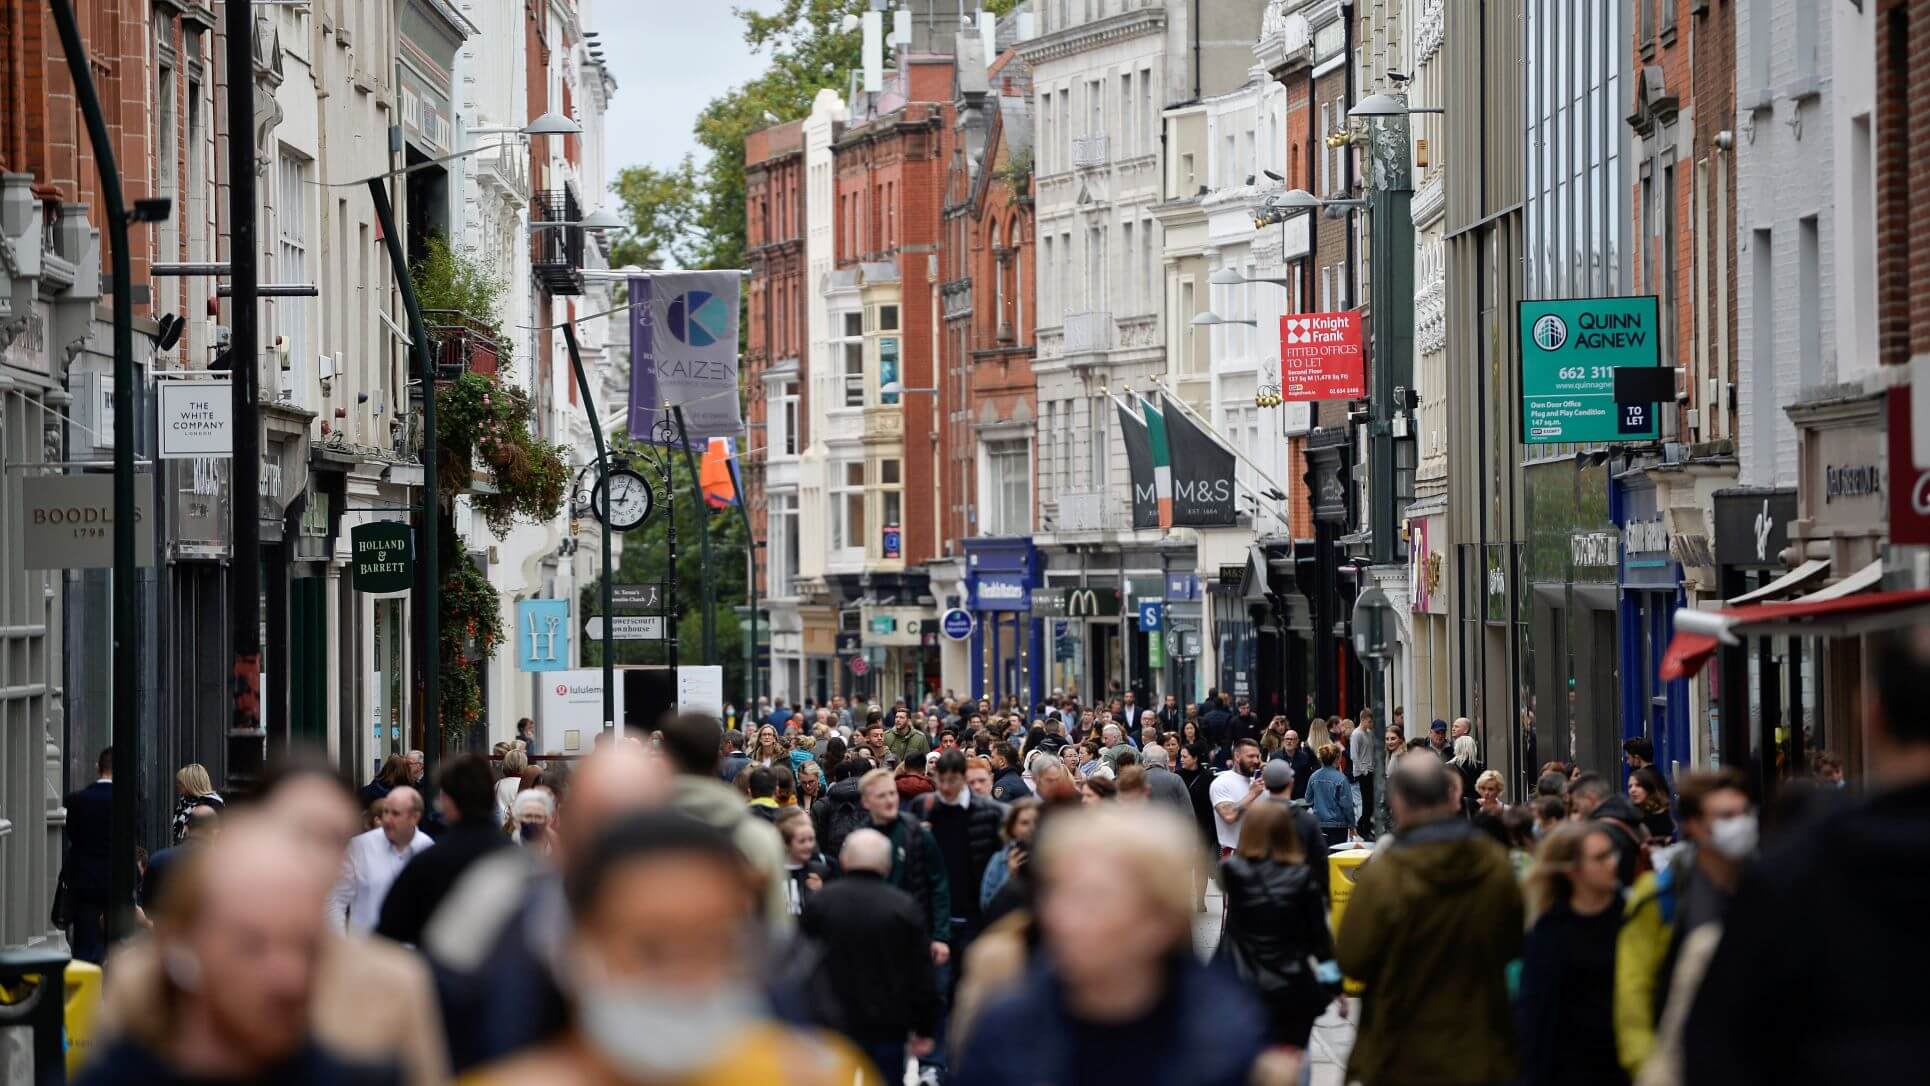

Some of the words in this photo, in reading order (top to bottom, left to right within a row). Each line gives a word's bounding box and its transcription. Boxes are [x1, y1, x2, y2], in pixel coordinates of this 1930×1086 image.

[1312, 317, 1350, 331] Knight
[1578, 312, 1641, 330] QUINN
[1312, 331, 1345, 342] Frank
[1574, 332, 1646, 349] AGNEW
[1287, 346, 1319, 357] FITTED
[1320, 344, 1358, 356] OFFICES
[1288, 359, 1302, 368] TO
[1305, 358, 1323, 367] LET
[657, 360, 737, 380] KAIZEN
[1559, 367, 1586, 379] 662
[1591, 366, 1615, 379] 311
[1556, 382, 1613, 390] www.quinnagne
[189, 402, 209, 410] THE
[1627, 406, 1642, 416] TO
[181, 411, 214, 420] WHITE
[1531, 410, 1546, 418] Plug
[1559, 410, 1573, 418] Play
[173, 422, 224, 430] COMPANY
[1626, 416, 1644, 426] LET
[1175, 479, 1229, 502] M&S
[33, 506, 142, 525] BOODLS
[359, 539, 405, 552] HOLLAND
[378, 550, 386, 562] &
[360, 562, 405, 575] BARRETT
[613, 617, 655, 625] owerscourt
[1146, 607, 1157, 626] S
[569, 684, 603, 695] lululem
